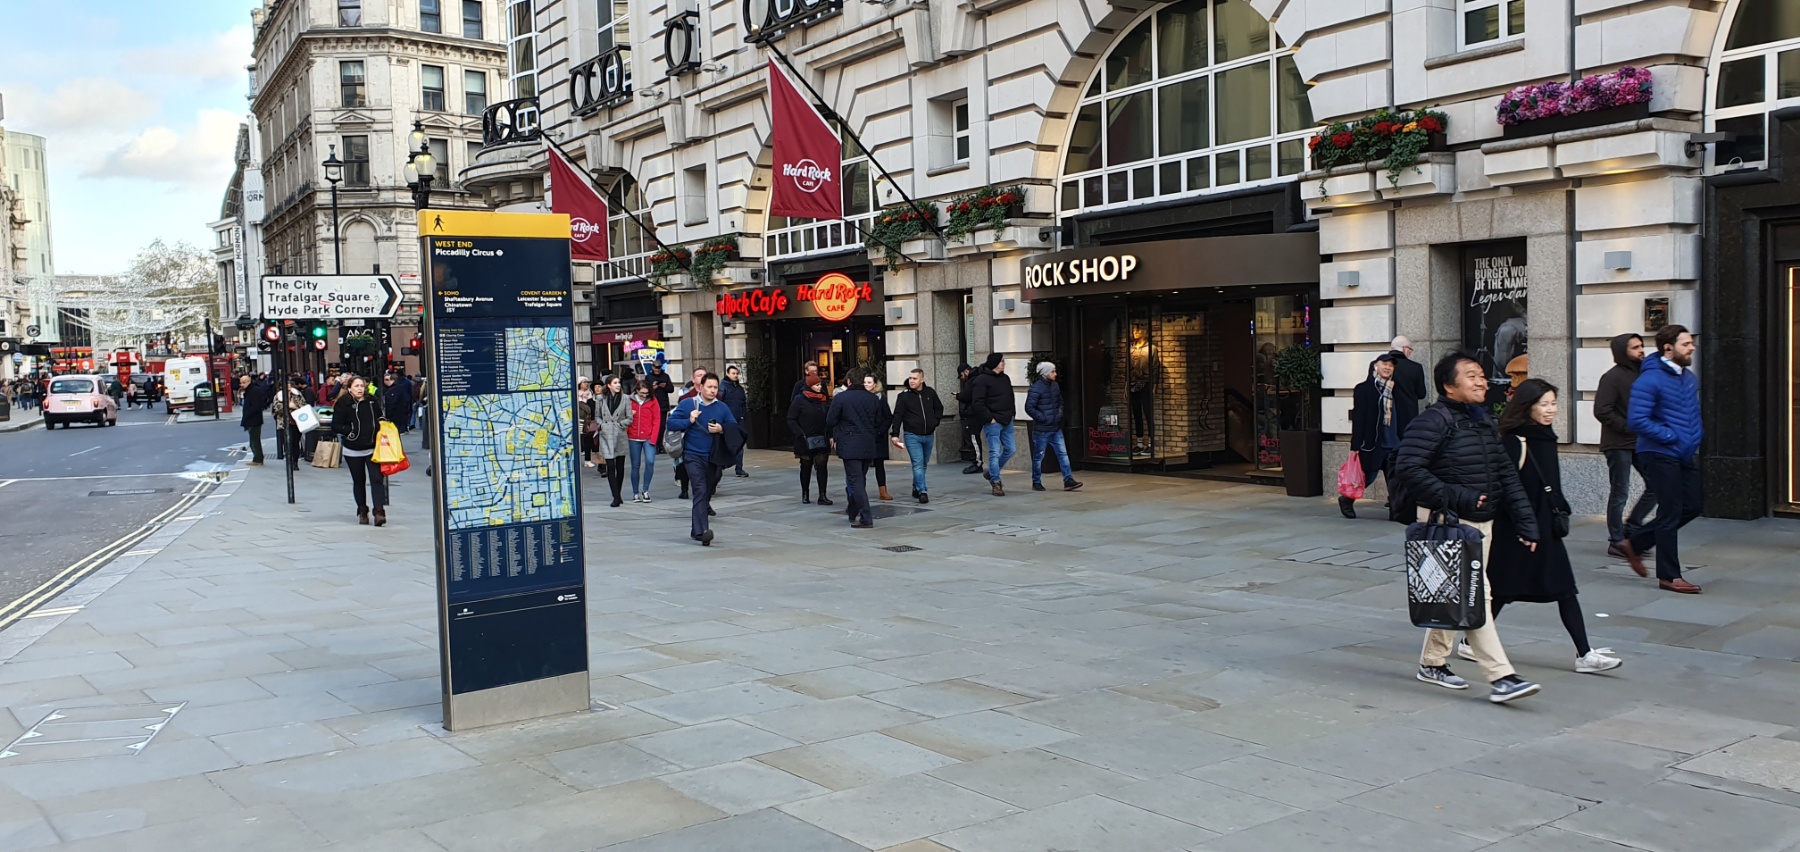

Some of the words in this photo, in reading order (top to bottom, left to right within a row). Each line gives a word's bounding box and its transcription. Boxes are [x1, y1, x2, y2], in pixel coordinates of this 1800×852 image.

[783, 164, 807, 177] Hard
[808, 166, 831, 182] Rock
[570, 222, 579, 231] rd
[579, 222, 599, 233] Rock
[435, 248, 470, 257] Piccadilly
[236, 261, 242, 272] OF
[1474, 258, 1490, 268] THE
[1492, 256, 1513, 267] ONLY
[1025, 262, 1066, 289] ROCK
[1069, 255, 1137, 283] SHOP
[1474, 267, 1508, 279] BURGER
[268, 281, 289, 289] The
[294, 280, 318, 291] City
[1476, 279, 1485, 290] OF
[1488, 278, 1502, 289] THE
[1504, 277, 1527, 288] NAME
[268, 293, 323, 304] Trafalgar
[328, 292, 370, 303] Square
[797, 283, 836, 301] Hard
[836, 282, 872, 302] Rock
[725, 292, 750, 318] Rock
[750, 289, 788, 315] Cafe
[268, 306, 298, 316] Hyde
[304, 305, 330, 314] Park
[335, 304, 374, 314] Corner
[1468, 570, 1480, 607] lululemon
